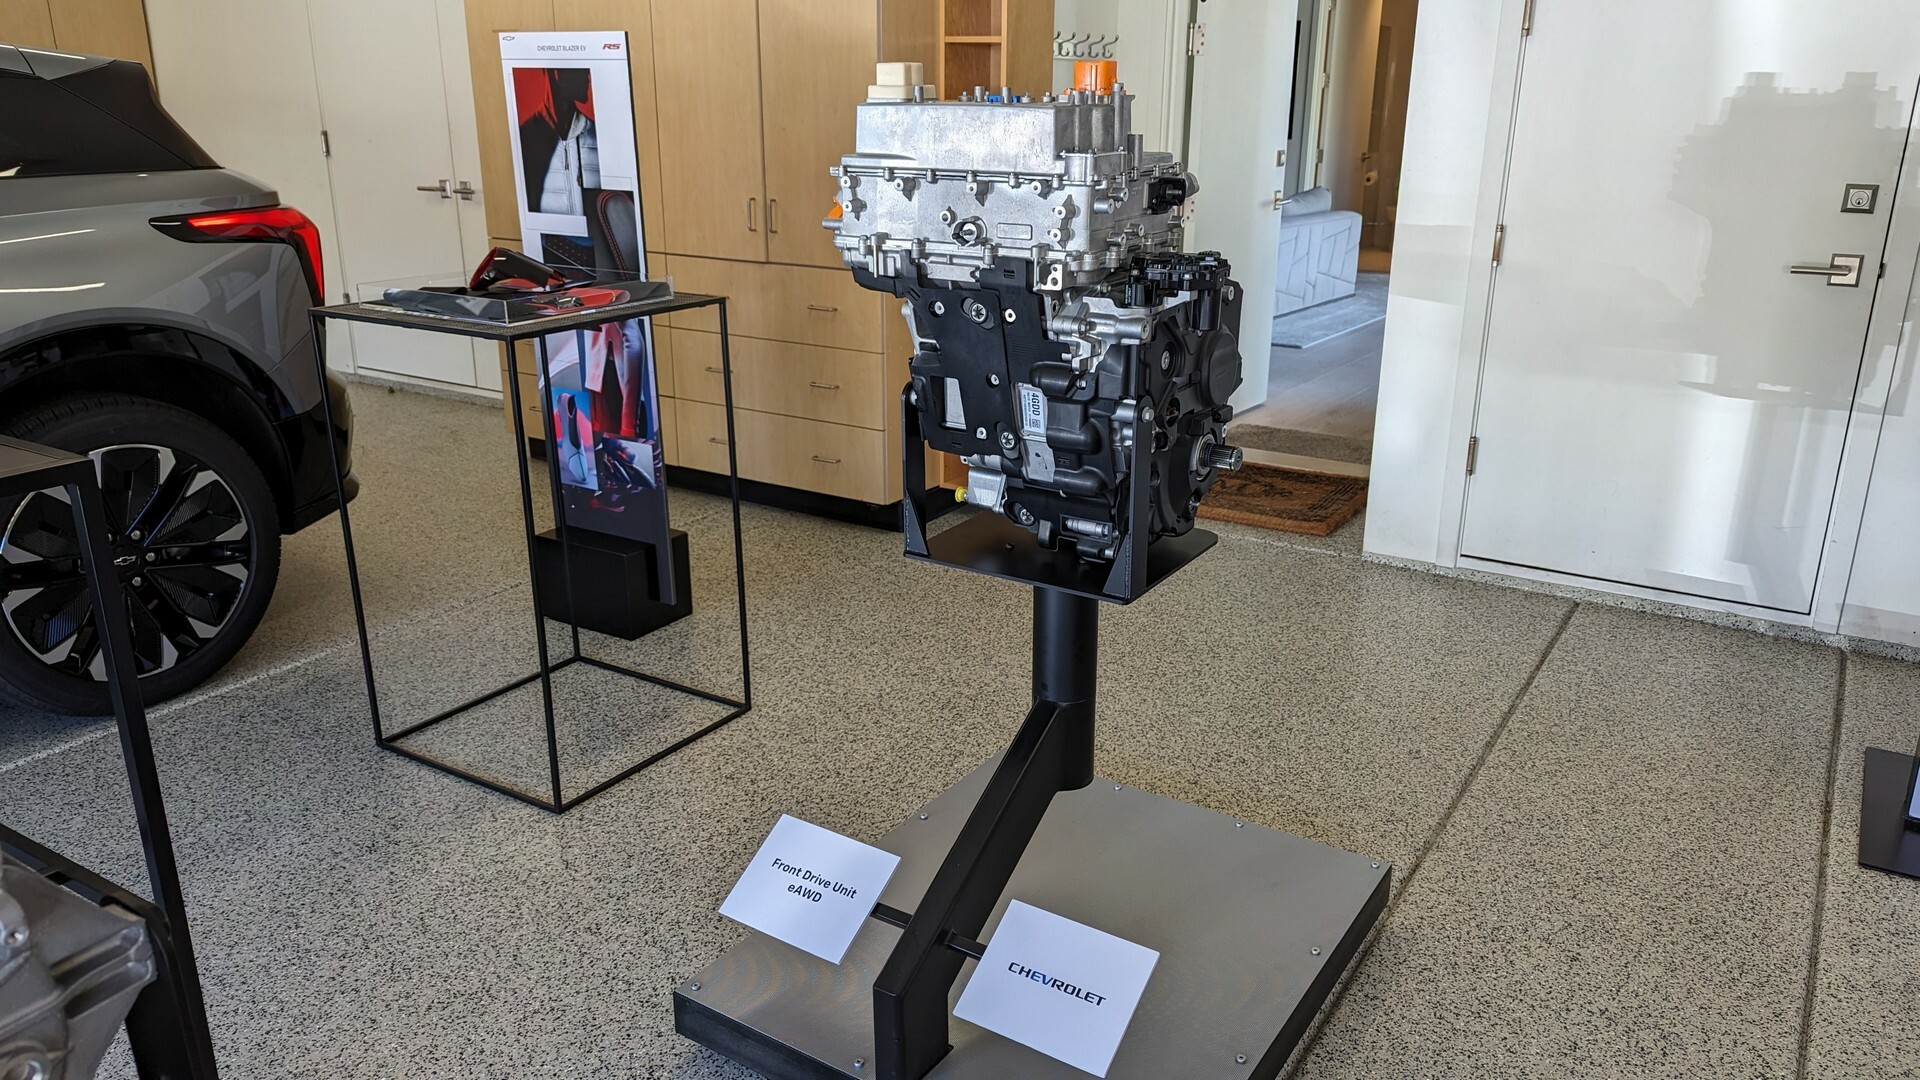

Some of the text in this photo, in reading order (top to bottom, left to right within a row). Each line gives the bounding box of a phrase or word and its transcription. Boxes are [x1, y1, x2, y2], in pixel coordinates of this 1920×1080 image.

[771, 858, 858, 899] Front Drive Unit
[787, 884, 823, 903] eAWD
[1008, 962, 1106, 1007] CHEVROLET
